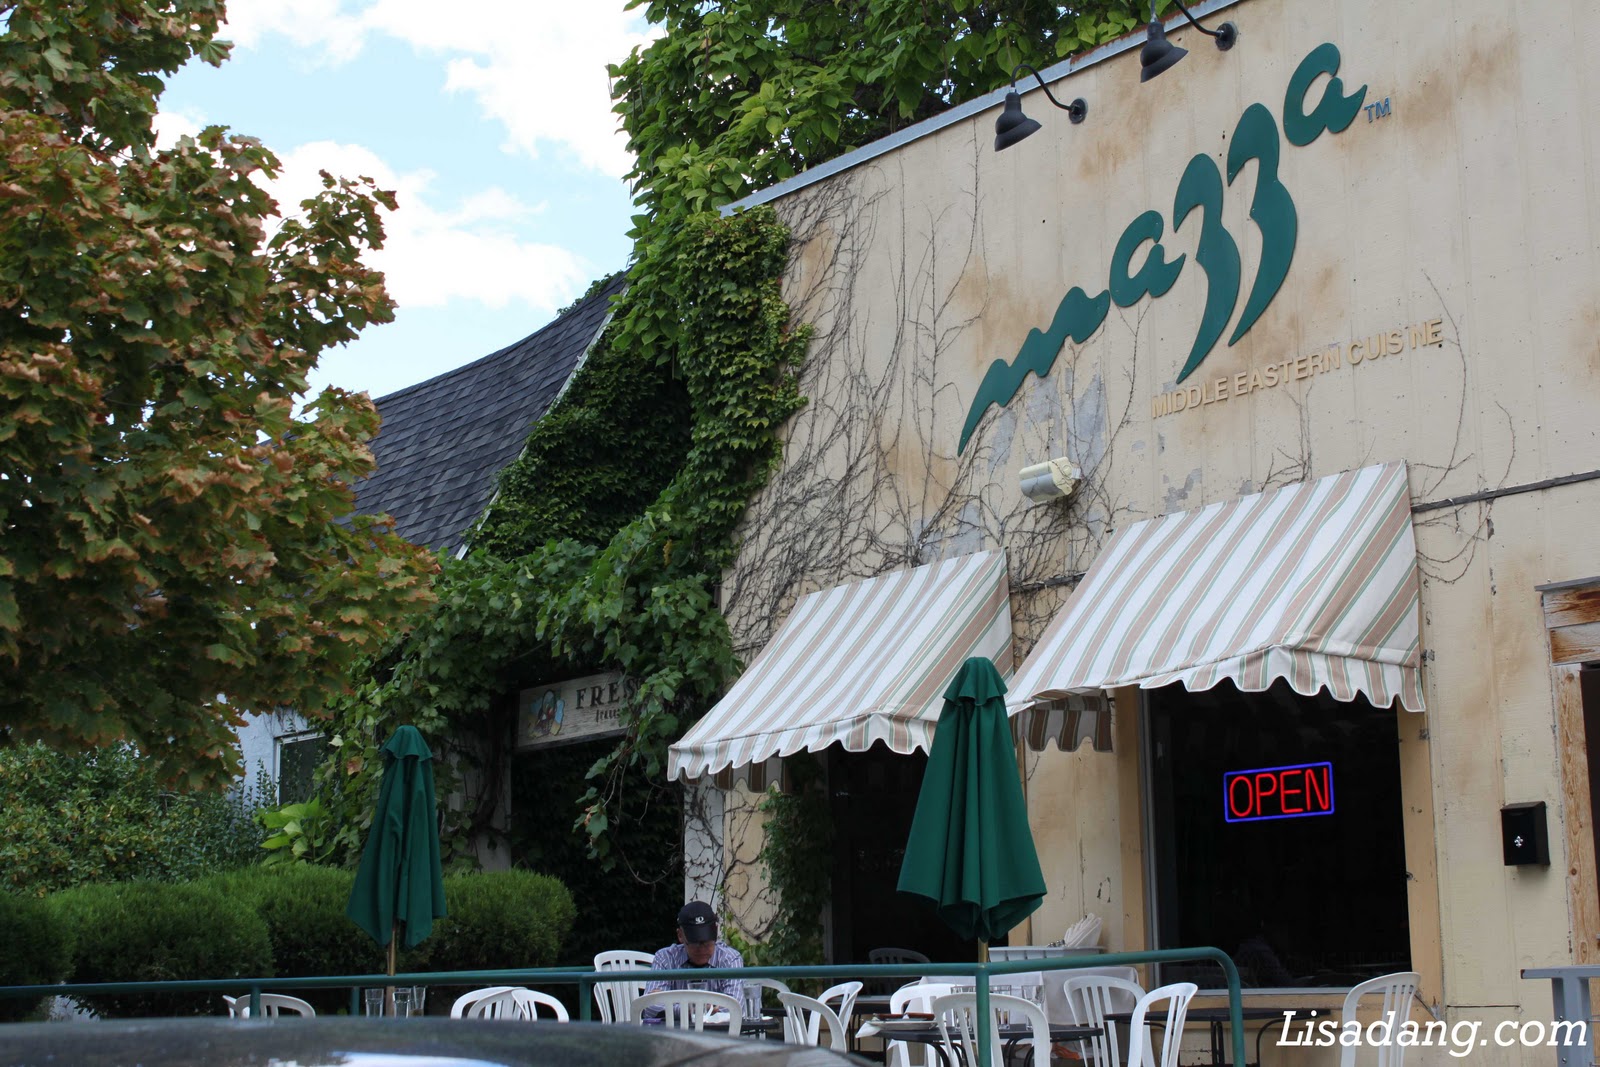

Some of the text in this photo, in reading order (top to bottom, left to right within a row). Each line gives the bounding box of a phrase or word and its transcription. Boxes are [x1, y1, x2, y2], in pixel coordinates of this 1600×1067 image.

[1364, 97, 1391, 123] TM
[958, 42, 1367, 457] mazza
[1151, 318, 1443, 419] MIDDLE EASTERN CUISNE
[1229, 767, 1329, 817] OPEN
